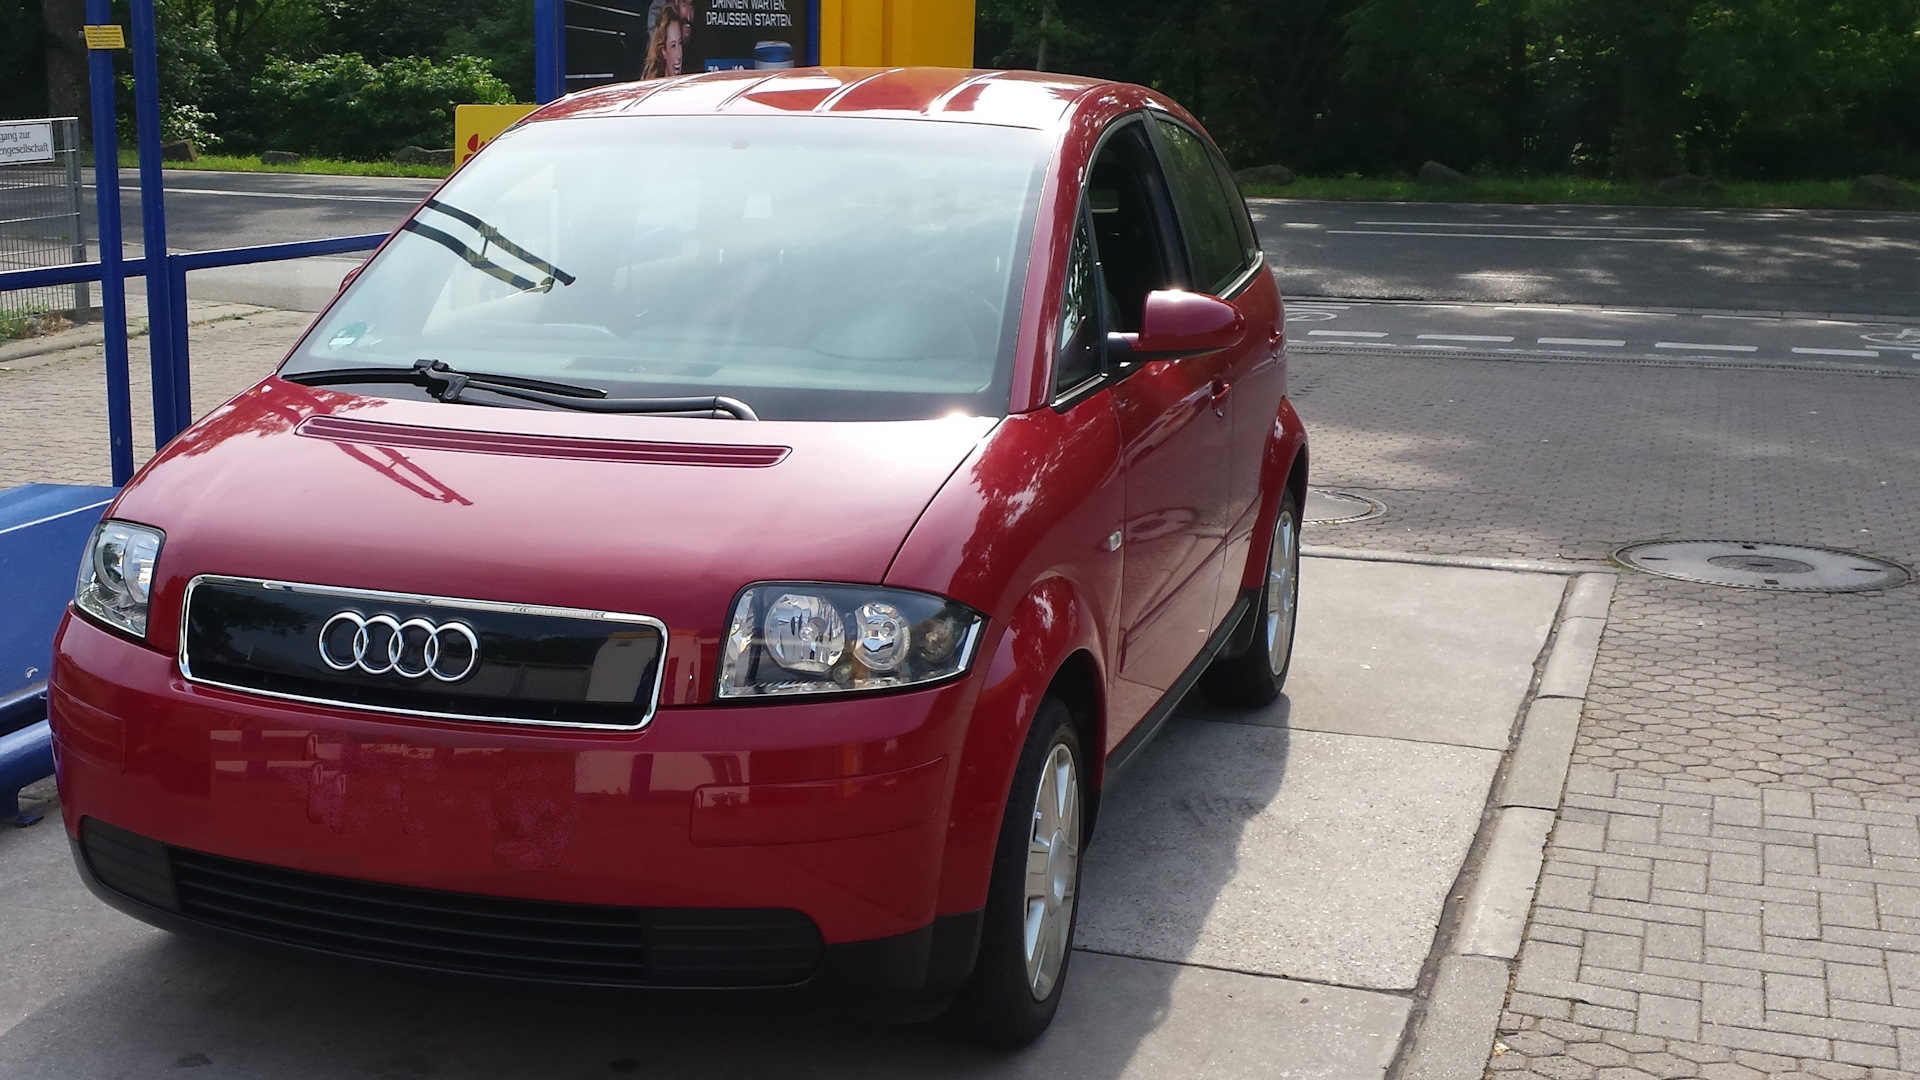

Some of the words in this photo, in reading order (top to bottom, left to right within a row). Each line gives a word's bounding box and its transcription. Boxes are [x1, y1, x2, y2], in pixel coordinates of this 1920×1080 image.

[712, 0, 749, 9] DRINNEN
[706, 11, 752, 26] DRAUSSEN
[755, 13, 793, 27] STARTEN.
